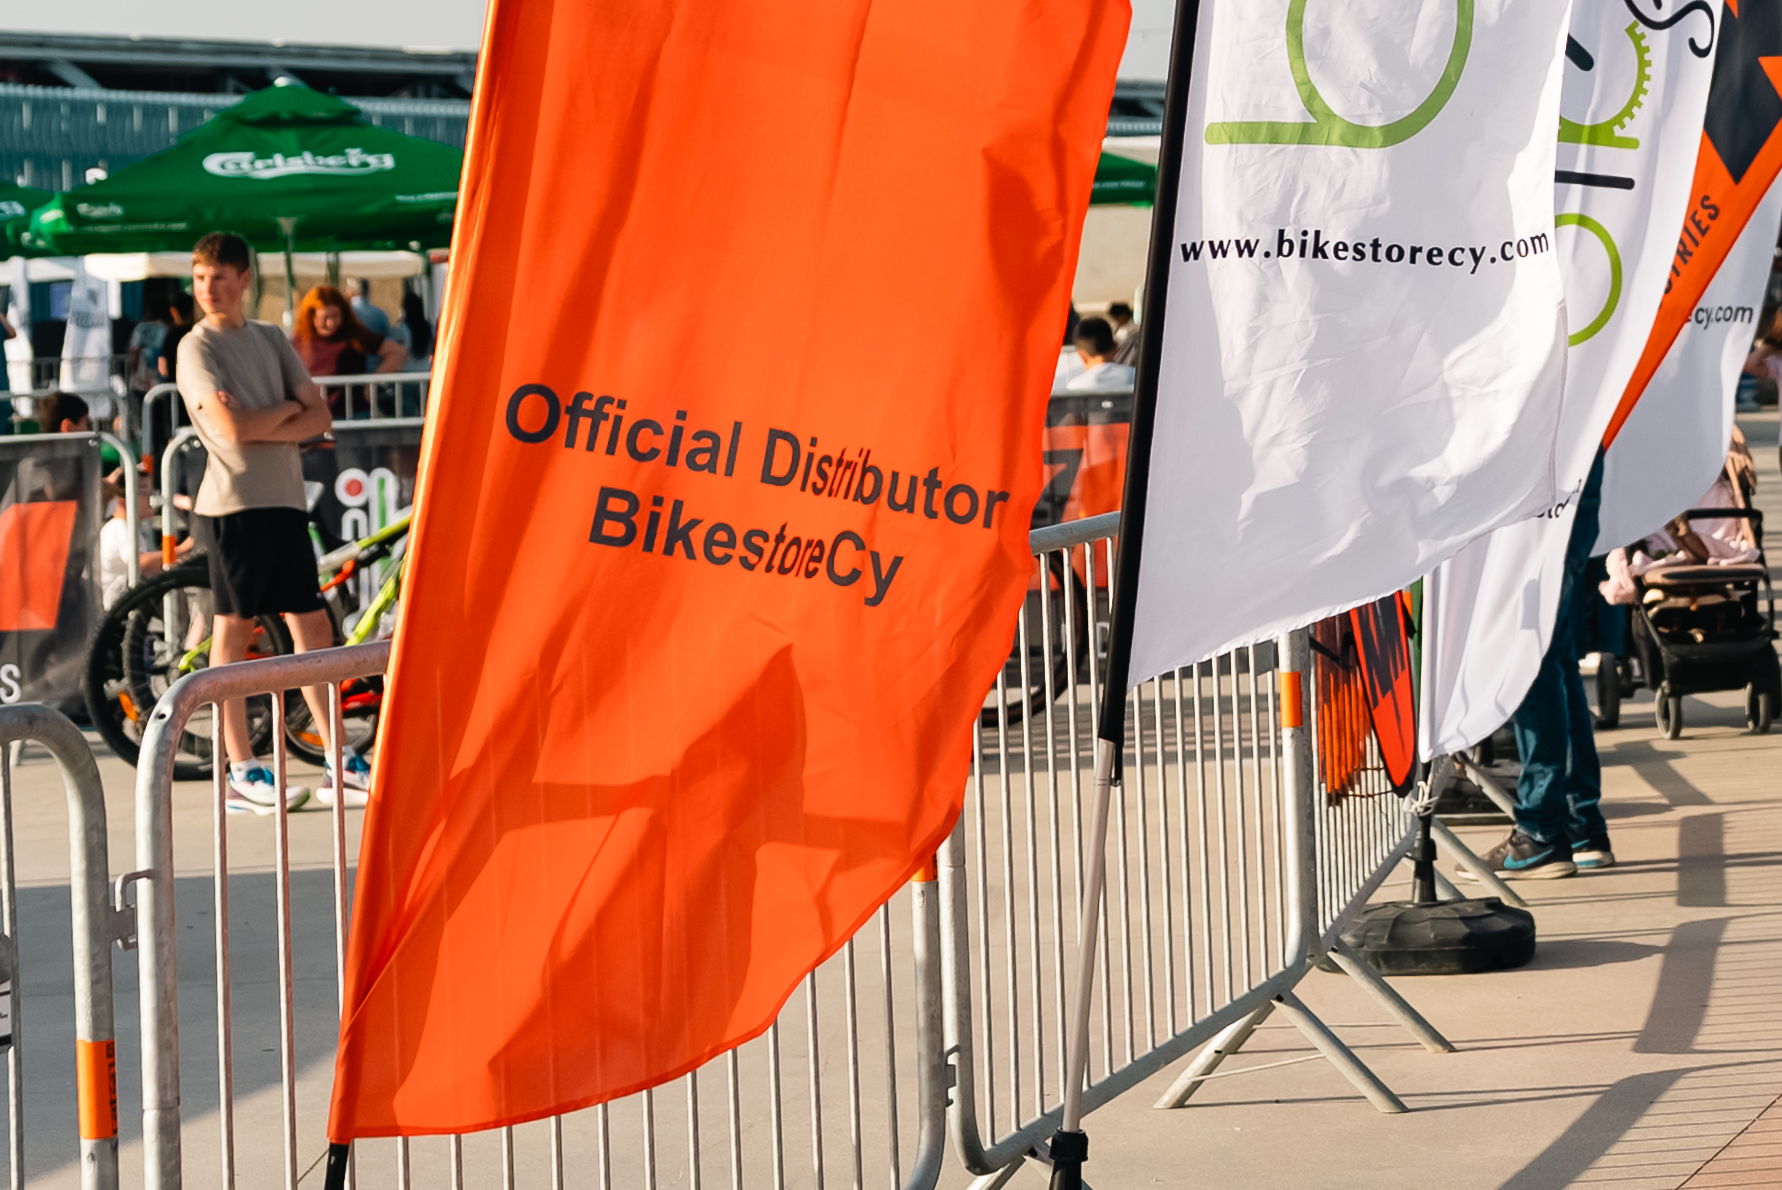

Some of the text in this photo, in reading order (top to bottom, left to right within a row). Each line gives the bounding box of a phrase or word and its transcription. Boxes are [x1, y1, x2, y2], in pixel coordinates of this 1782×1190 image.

[202, 147, 396, 180] Carlsberg
[1180, 228, 1549, 274] www.bikestorecy.com
[505, 383, 742, 477] Official
[760, 428, 1010, 529] Distributor
[588, 486, 903, 606] BikestoreCy
